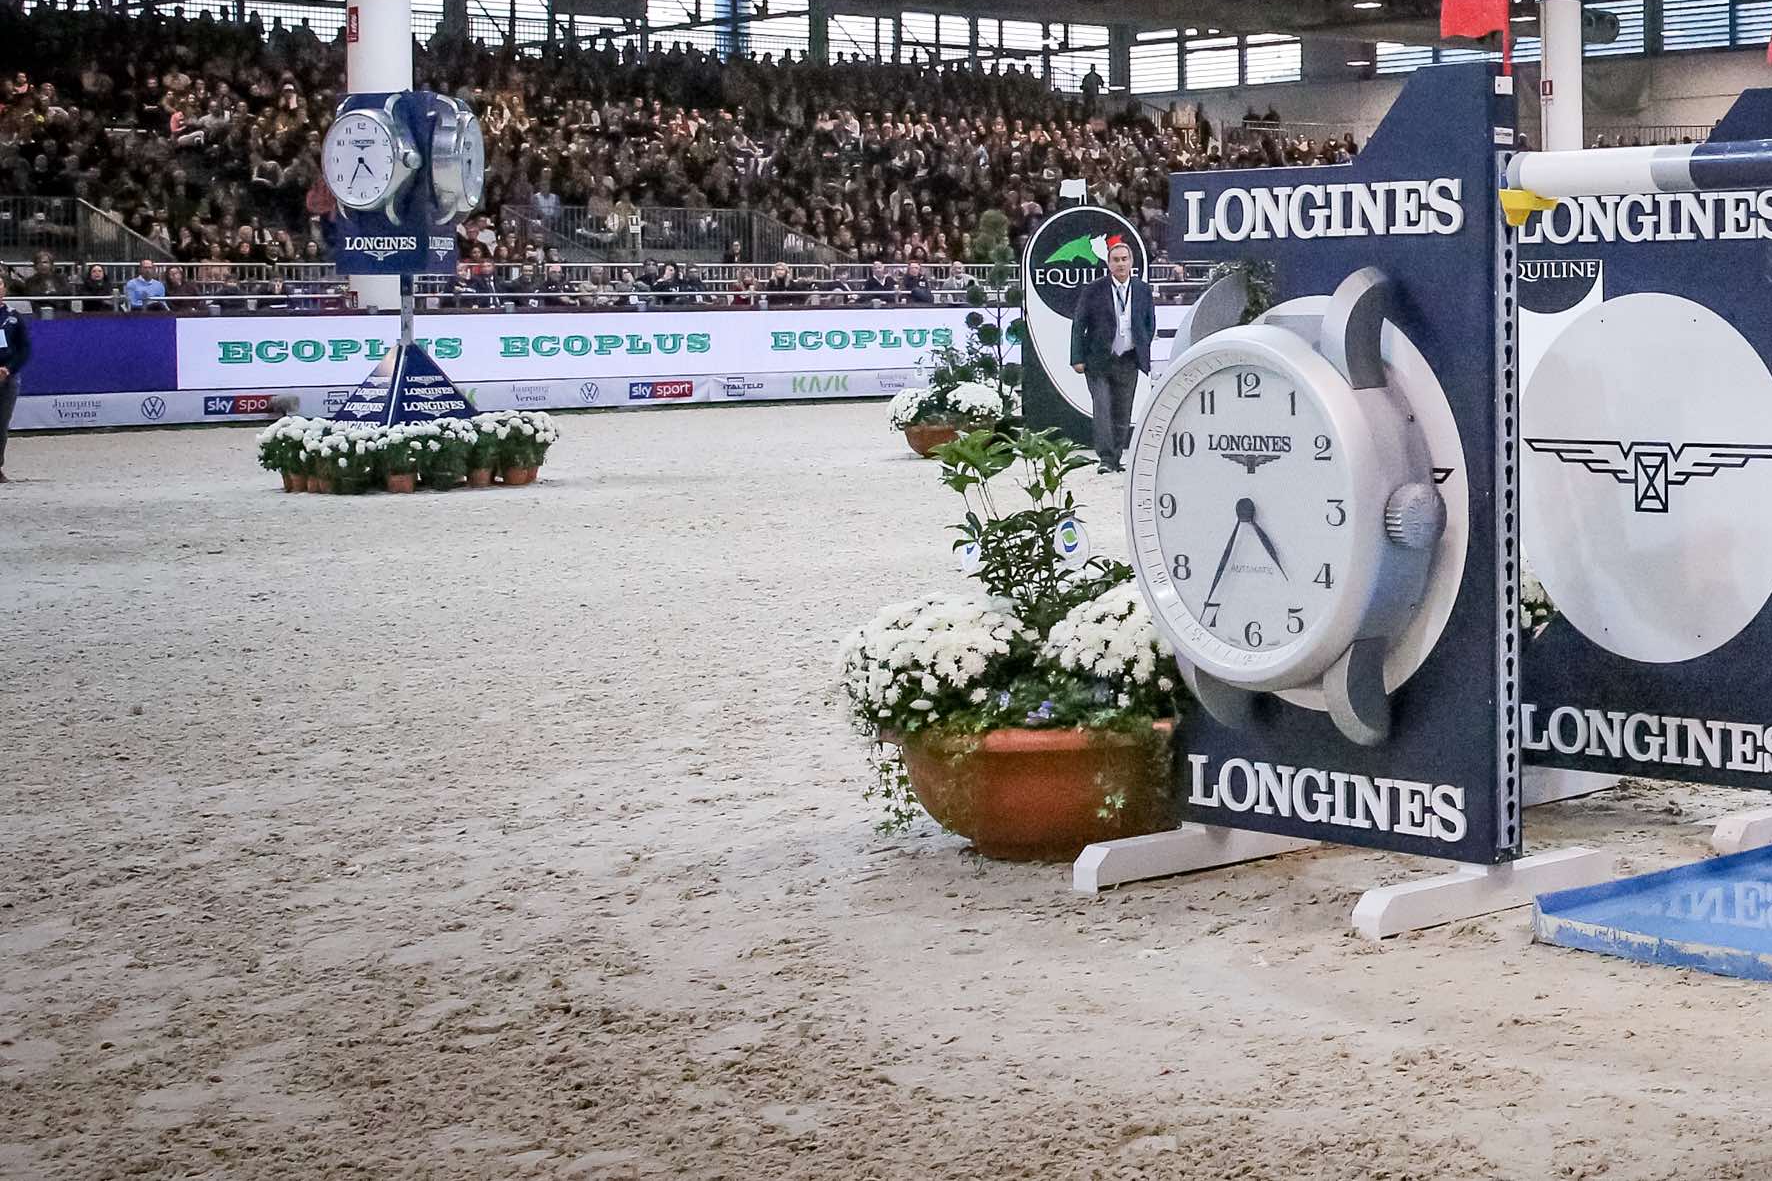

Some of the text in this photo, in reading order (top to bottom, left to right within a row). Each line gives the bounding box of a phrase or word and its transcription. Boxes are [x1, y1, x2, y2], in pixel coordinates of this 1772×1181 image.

[1183, 178, 1464, 242] LONGINES
[345, 236, 417, 251] LONGINES
[429, 236, 454, 250] LONGINES
[217, 328, 953, 364] ECOPLS ECOPLUS ECOPLUS
[404, 386, 455, 396] LONGINES
[631, 382, 691, 399] sky sport
[1235, 372, 1261, 398] 12
[207, 396, 270, 415] sky spo
[402, 400, 466, 412] LONGINES
[1200, 390, 1215, 415] 11
[1288, 390, 1297, 416] 1
[1170, 431, 1196, 458] 10
[1207, 433, 1292, 453] LONGINES
[1313, 435, 1333, 461] 2
[1159, 493, 1177, 519] 9
[1325, 499, 1346, 527] 3
[1172, 554, 1191, 581] 8
[1312, 563, 1335, 589] 4
[1286, 607, 1304, 634] 5
[1244, 621, 1263, 648] 6
[1188, 753, 1467, 843] LONGINES
